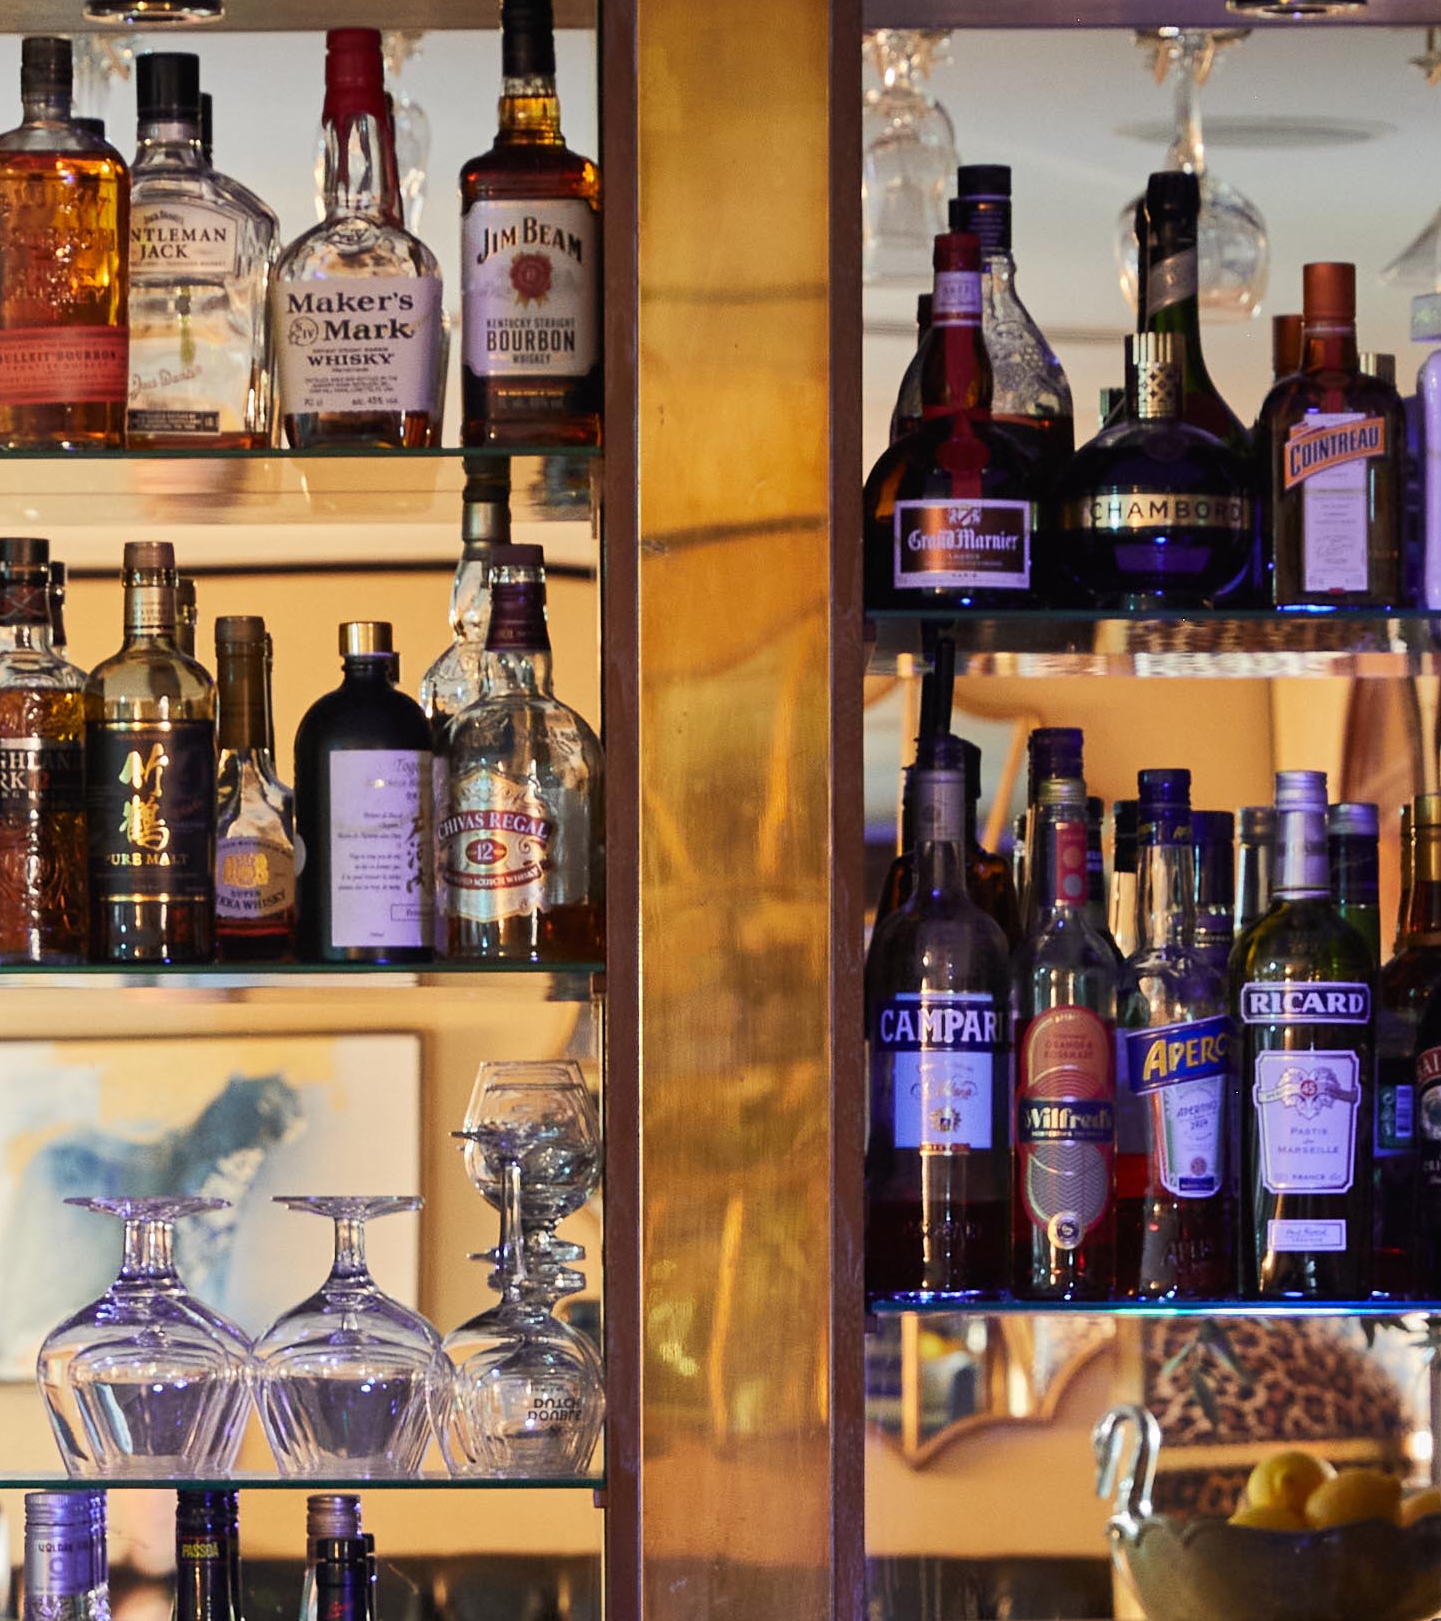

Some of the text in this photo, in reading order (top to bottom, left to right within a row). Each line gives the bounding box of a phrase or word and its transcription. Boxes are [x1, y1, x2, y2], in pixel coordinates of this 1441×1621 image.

[130, 227, 227, 243] NTLEMAN
[476, 216, 583, 265] JIM BEAM
[139, 244, 189, 260] JACK
[287, 292, 414, 314] Maker's
[323, 318, 414, 341] Mark
[487, 317, 576, 330] KENTUCKY STRAIGHT
[486, 330, 576, 352] BOURBON
[58, 350, 117, 362] BOURBON
[307, 353, 392, 367] WHISKY
[512, 353, 551, 365] WHISKEY
[1290, 426, 1380, 478] COINTREAU
[1090, 500, 1242, 523] CHAMBORD
[907, 527, 1019, 552] Grand Marnier
[437, 811, 548, 840] CHIVAS REGAL
[145, 852, 189, 867] MALT
[476, 841, 495, 861] 12
[1249, 990, 1365, 1016] RICARD
[879, 1008, 1004, 1044] CAMPARI
[1141, 1038, 1235, 1082] APERO
[1024, 1106, 1112, 1130] Wilfred's
[1289, 1127, 1328, 1136] PASTIS
[1277, 1146, 1340, 1155] MARSEILLE
